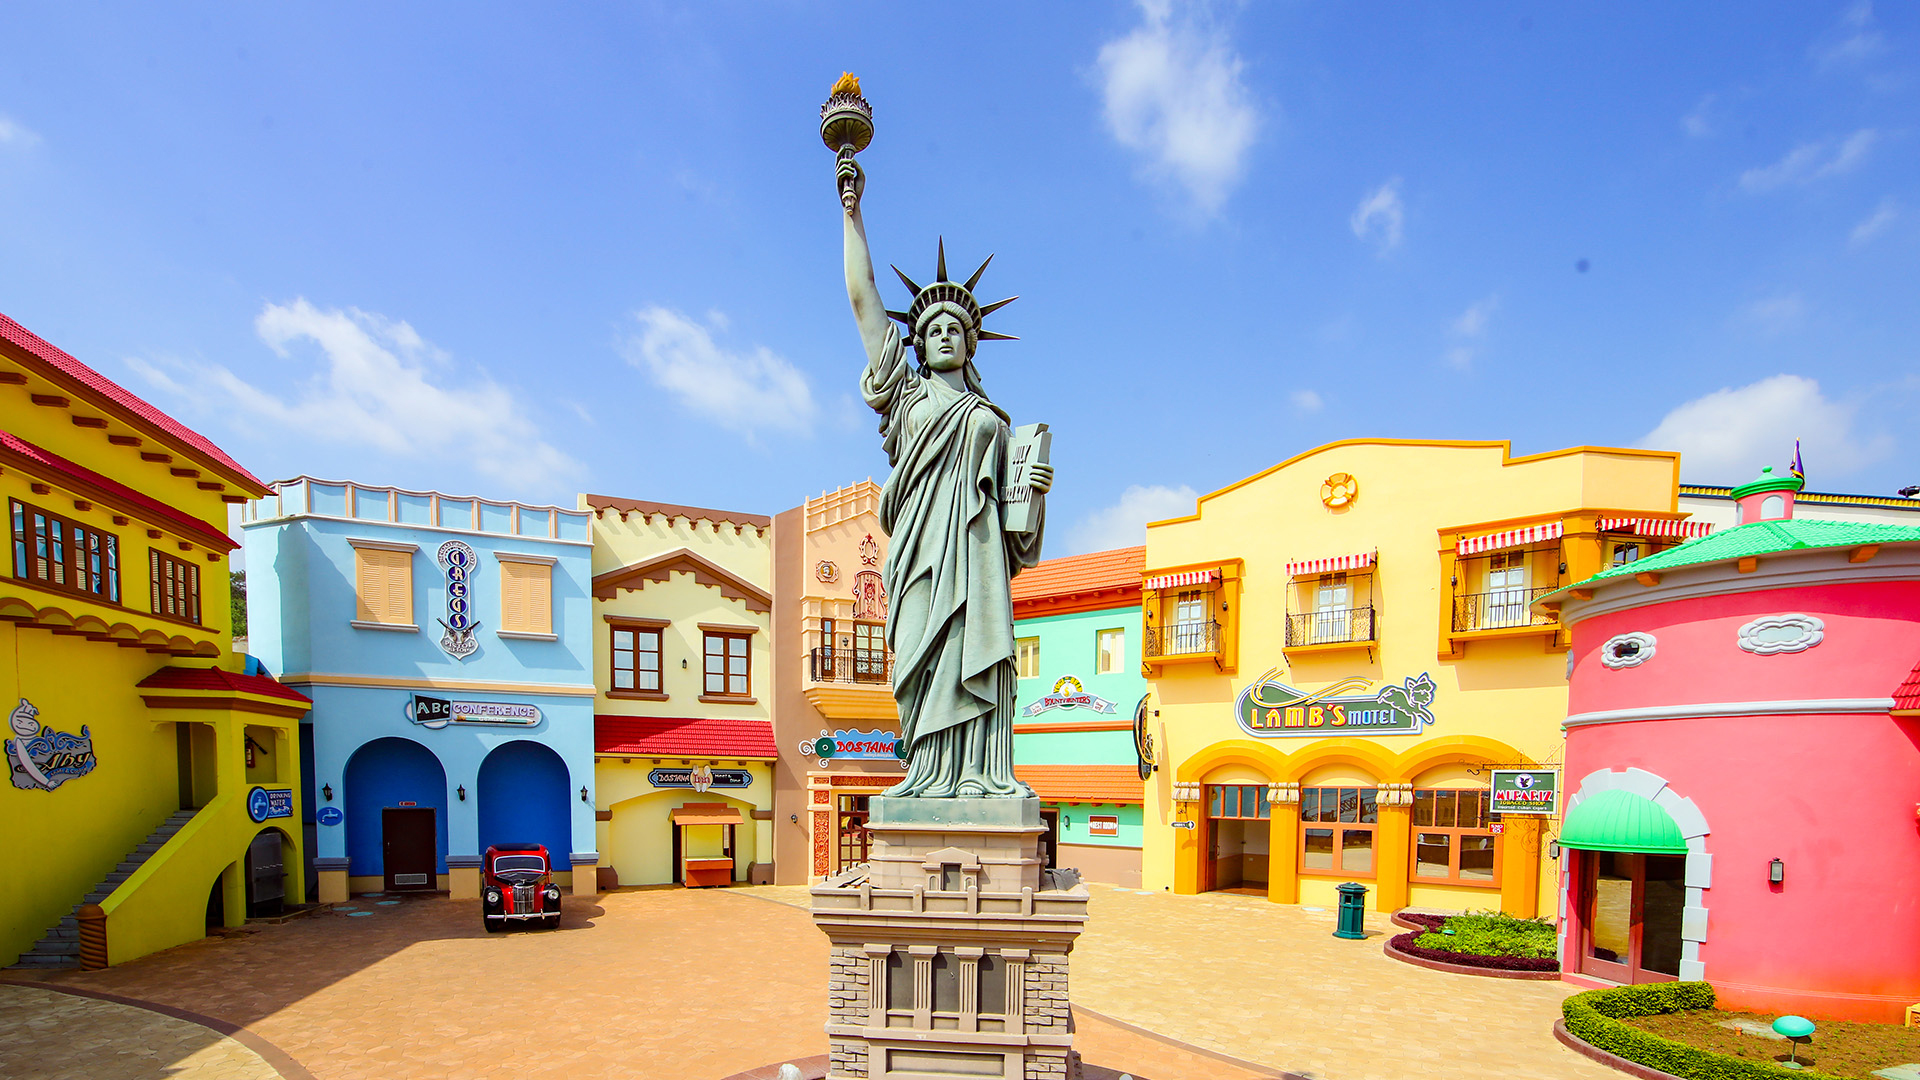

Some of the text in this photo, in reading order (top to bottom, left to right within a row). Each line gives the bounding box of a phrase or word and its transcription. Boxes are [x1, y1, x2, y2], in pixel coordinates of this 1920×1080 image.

[449, 550, 465, 628] GREGS
[444, 640, 474, 648] PISTOL
[1053, 678, 1066, 693] YOGI
[417, 702, 536, 717] ABC CONFERENCE
[1251, 703, 1397, 728] LAMB'S MOTEL
[836, 741, 894, 753] DOSTANA
[658, 773, 711, 784] DOSTANA Inn
[270, 799, 286, 807] WATER
